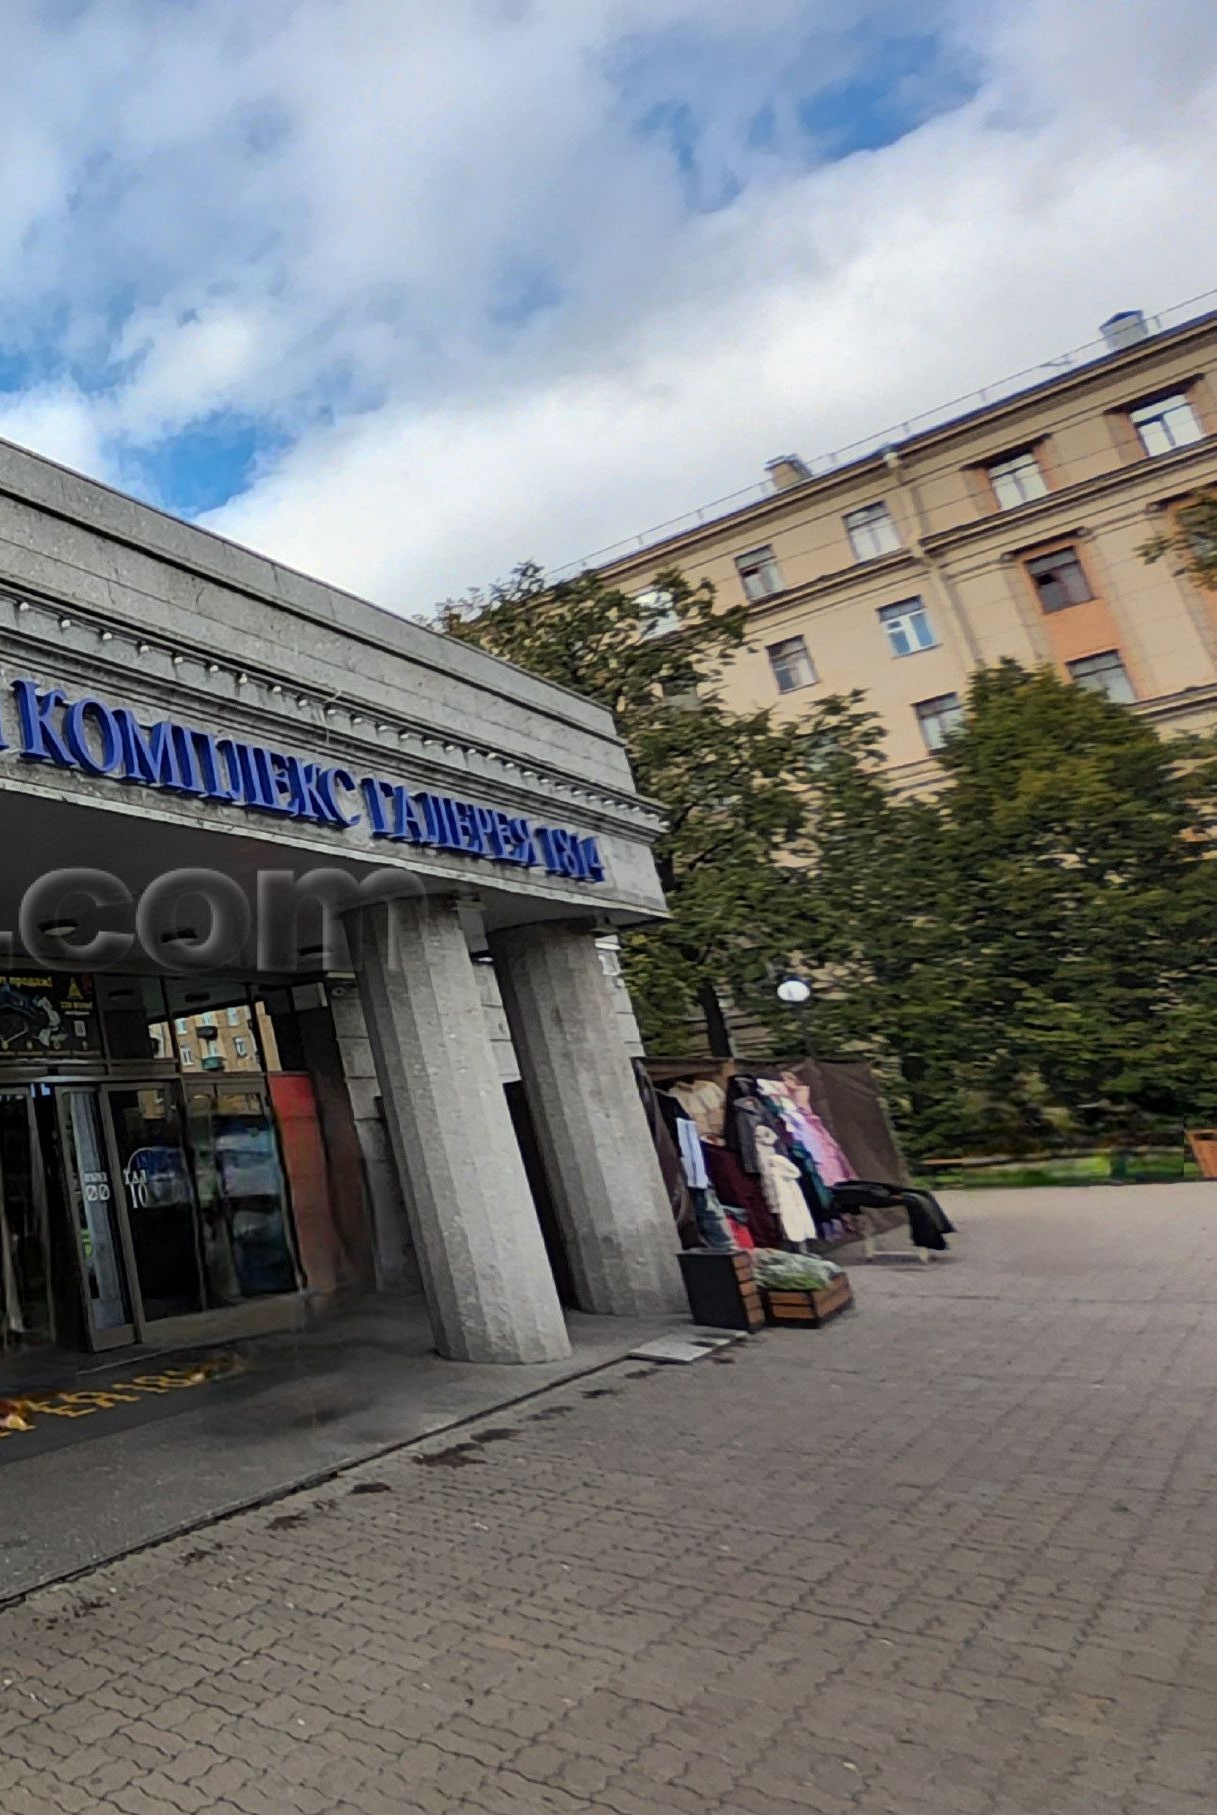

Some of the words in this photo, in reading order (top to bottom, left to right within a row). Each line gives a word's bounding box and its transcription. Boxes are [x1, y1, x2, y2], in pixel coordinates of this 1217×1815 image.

[11, 679, 363, 829] КОМПЛЕКС
[361, 776, 545, 868] ГАЛЕРЕЯ
[534, 825, 605, 883] 1814
